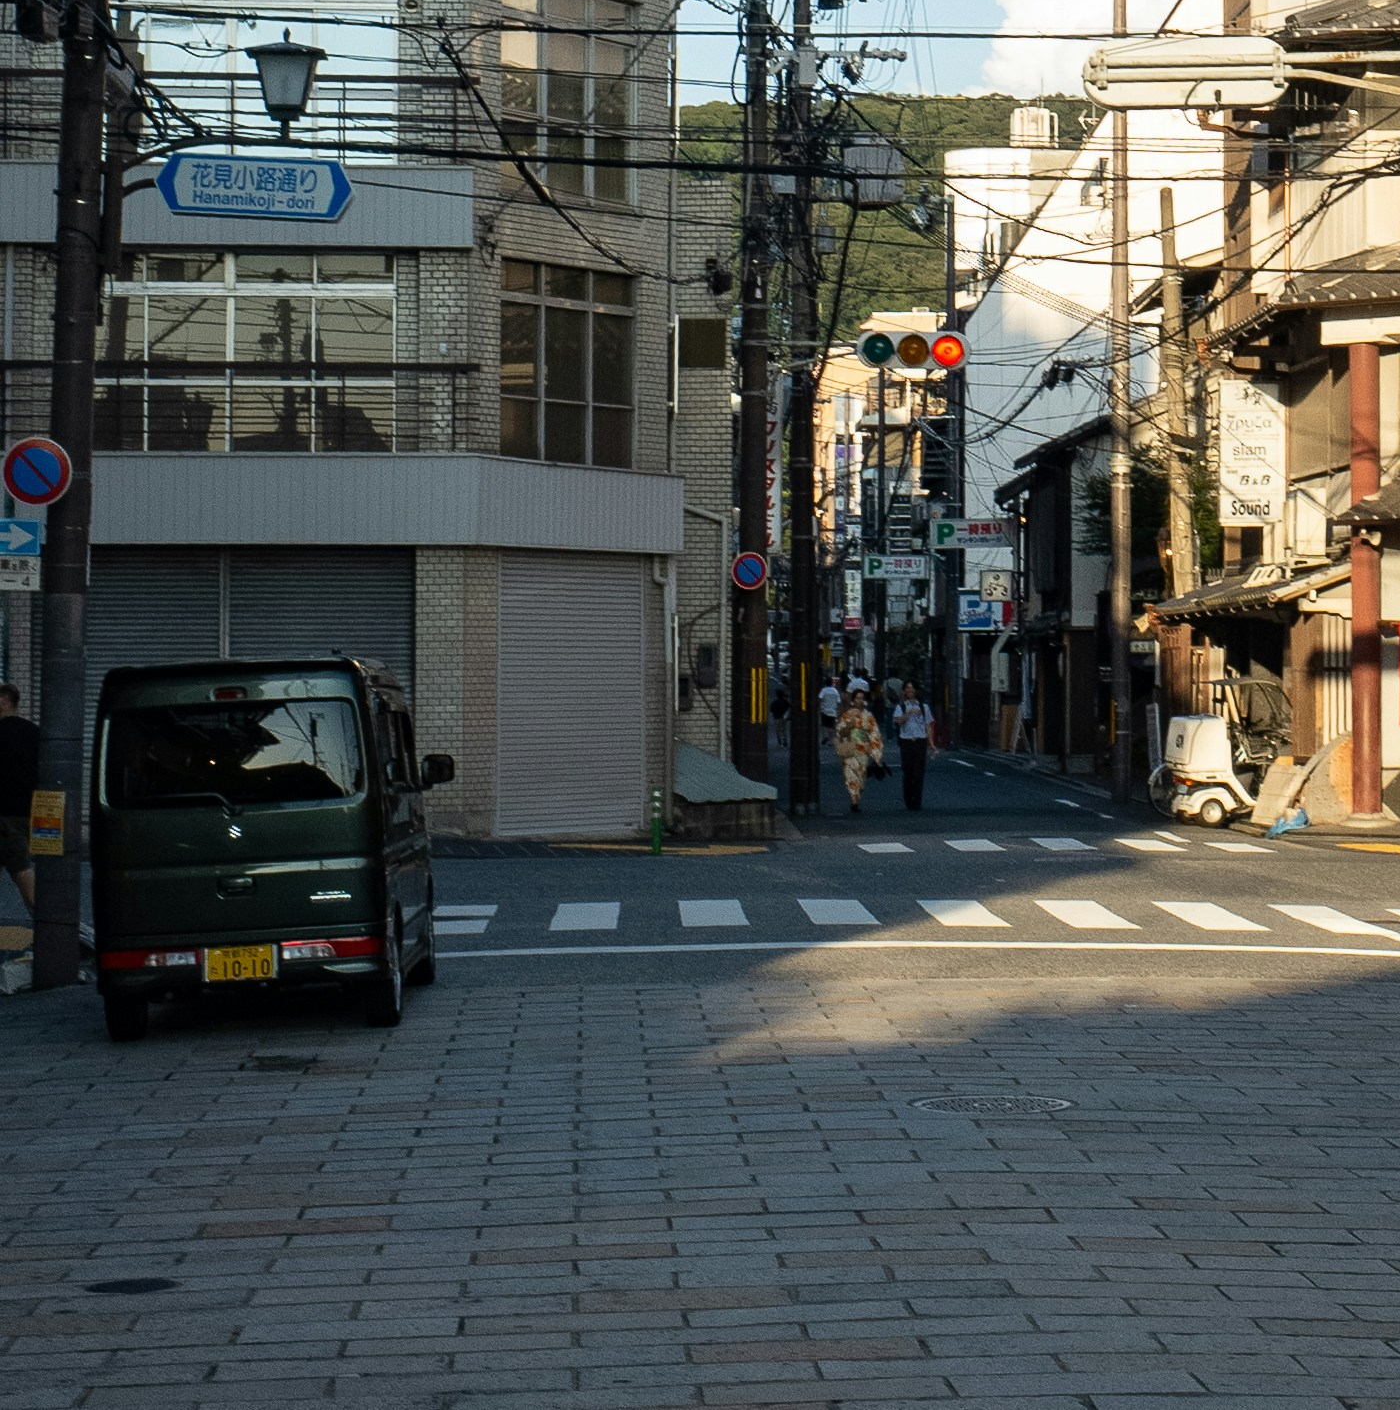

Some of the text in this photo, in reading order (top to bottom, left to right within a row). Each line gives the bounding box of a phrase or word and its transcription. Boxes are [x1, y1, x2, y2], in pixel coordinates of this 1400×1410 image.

[190, 163, 318, 193] 花見小路通り
[191, 190, 316, 209] Hanamikoji-dori
[1232, 444, 1267, 457] siam
[1231, 501, 1271, 516] Sound
[223, 958, 270, 979] 10-10
